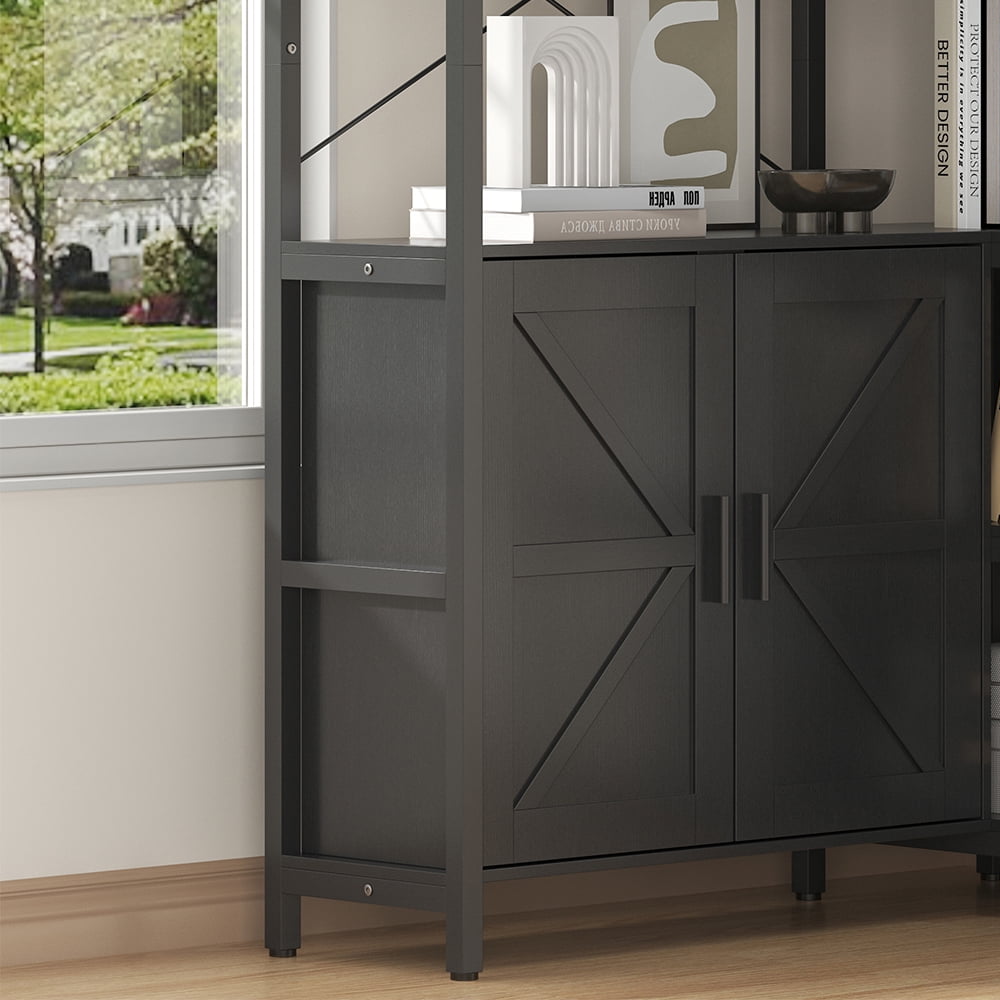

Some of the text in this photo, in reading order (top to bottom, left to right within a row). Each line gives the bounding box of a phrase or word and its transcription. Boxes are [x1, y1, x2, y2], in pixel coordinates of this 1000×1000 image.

[938, 40, 948, 176] BETTER DESIGN
[970, 24, 979, 197] PROTECT OUR DESIGN
